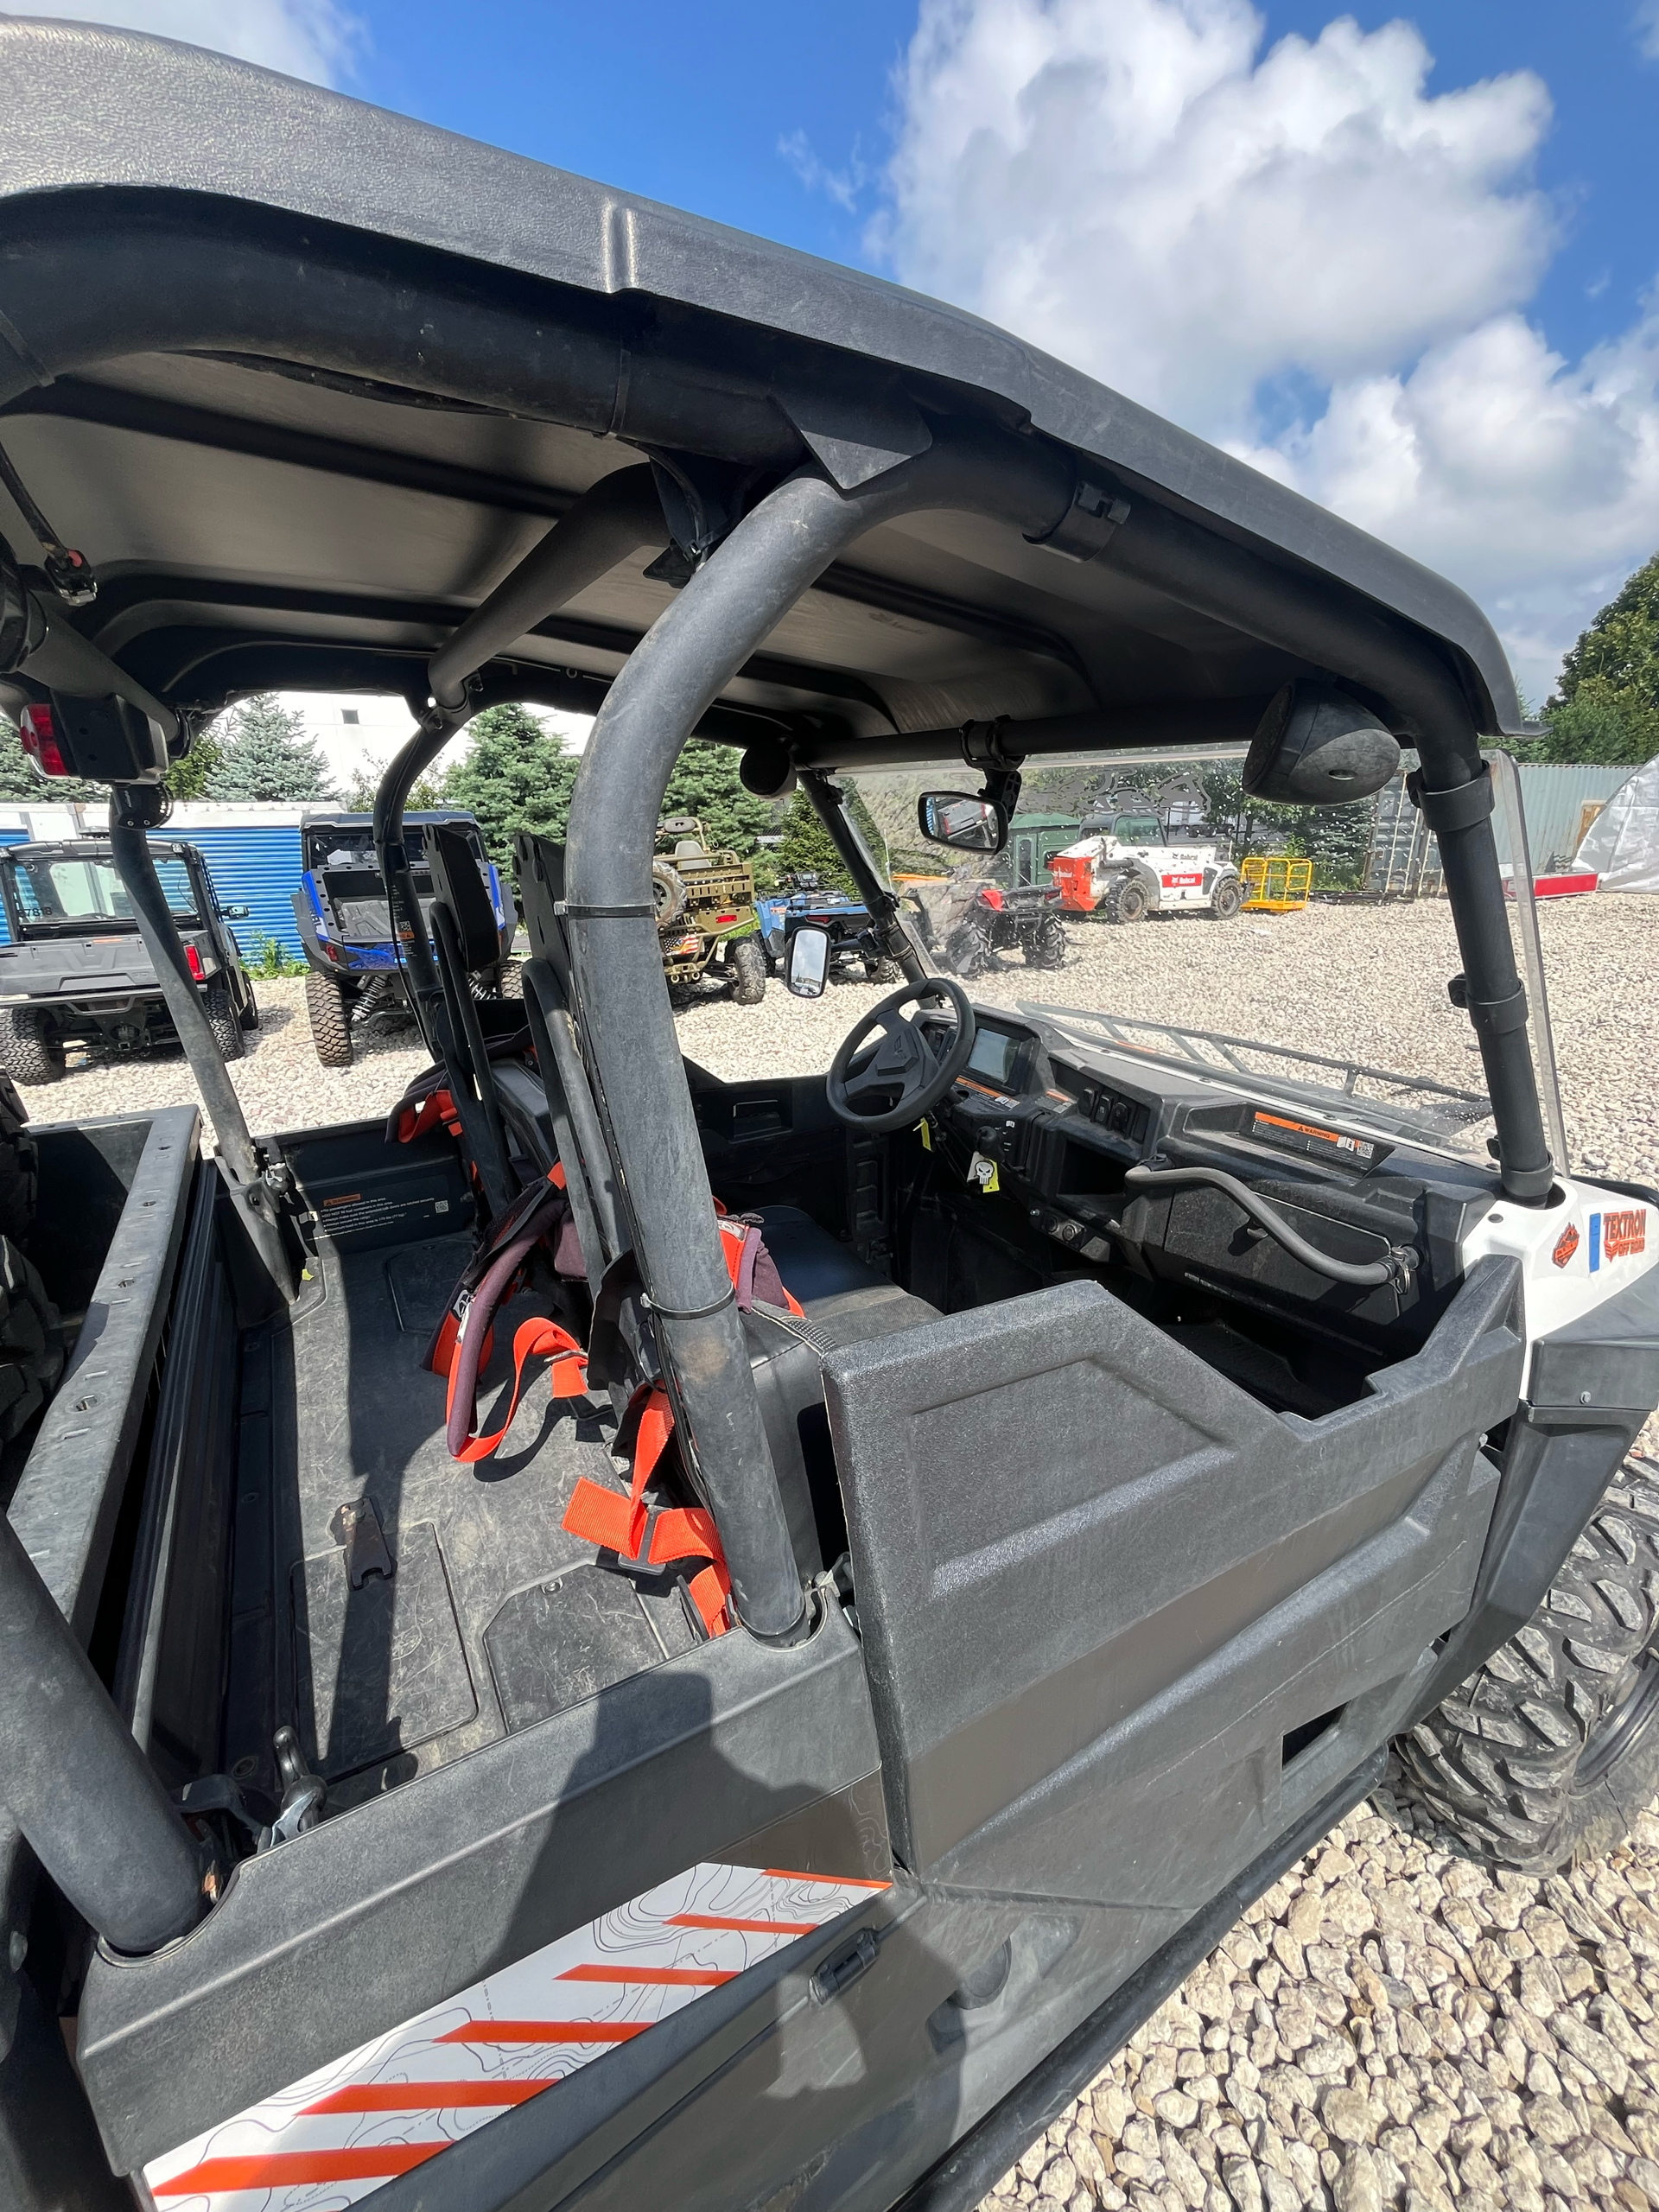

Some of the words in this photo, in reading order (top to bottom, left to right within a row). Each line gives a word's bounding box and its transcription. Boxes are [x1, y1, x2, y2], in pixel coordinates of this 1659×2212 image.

[1305, 1127, 1331, 1139] WARNING
[333, 1197, 358, 1205] WARNING
[1603, 1209, 1646, 1241] TEXTRON
[1618, 1243, 1630, 1256] OFF
[1630, 1237, 1645, 1255] ROAD
